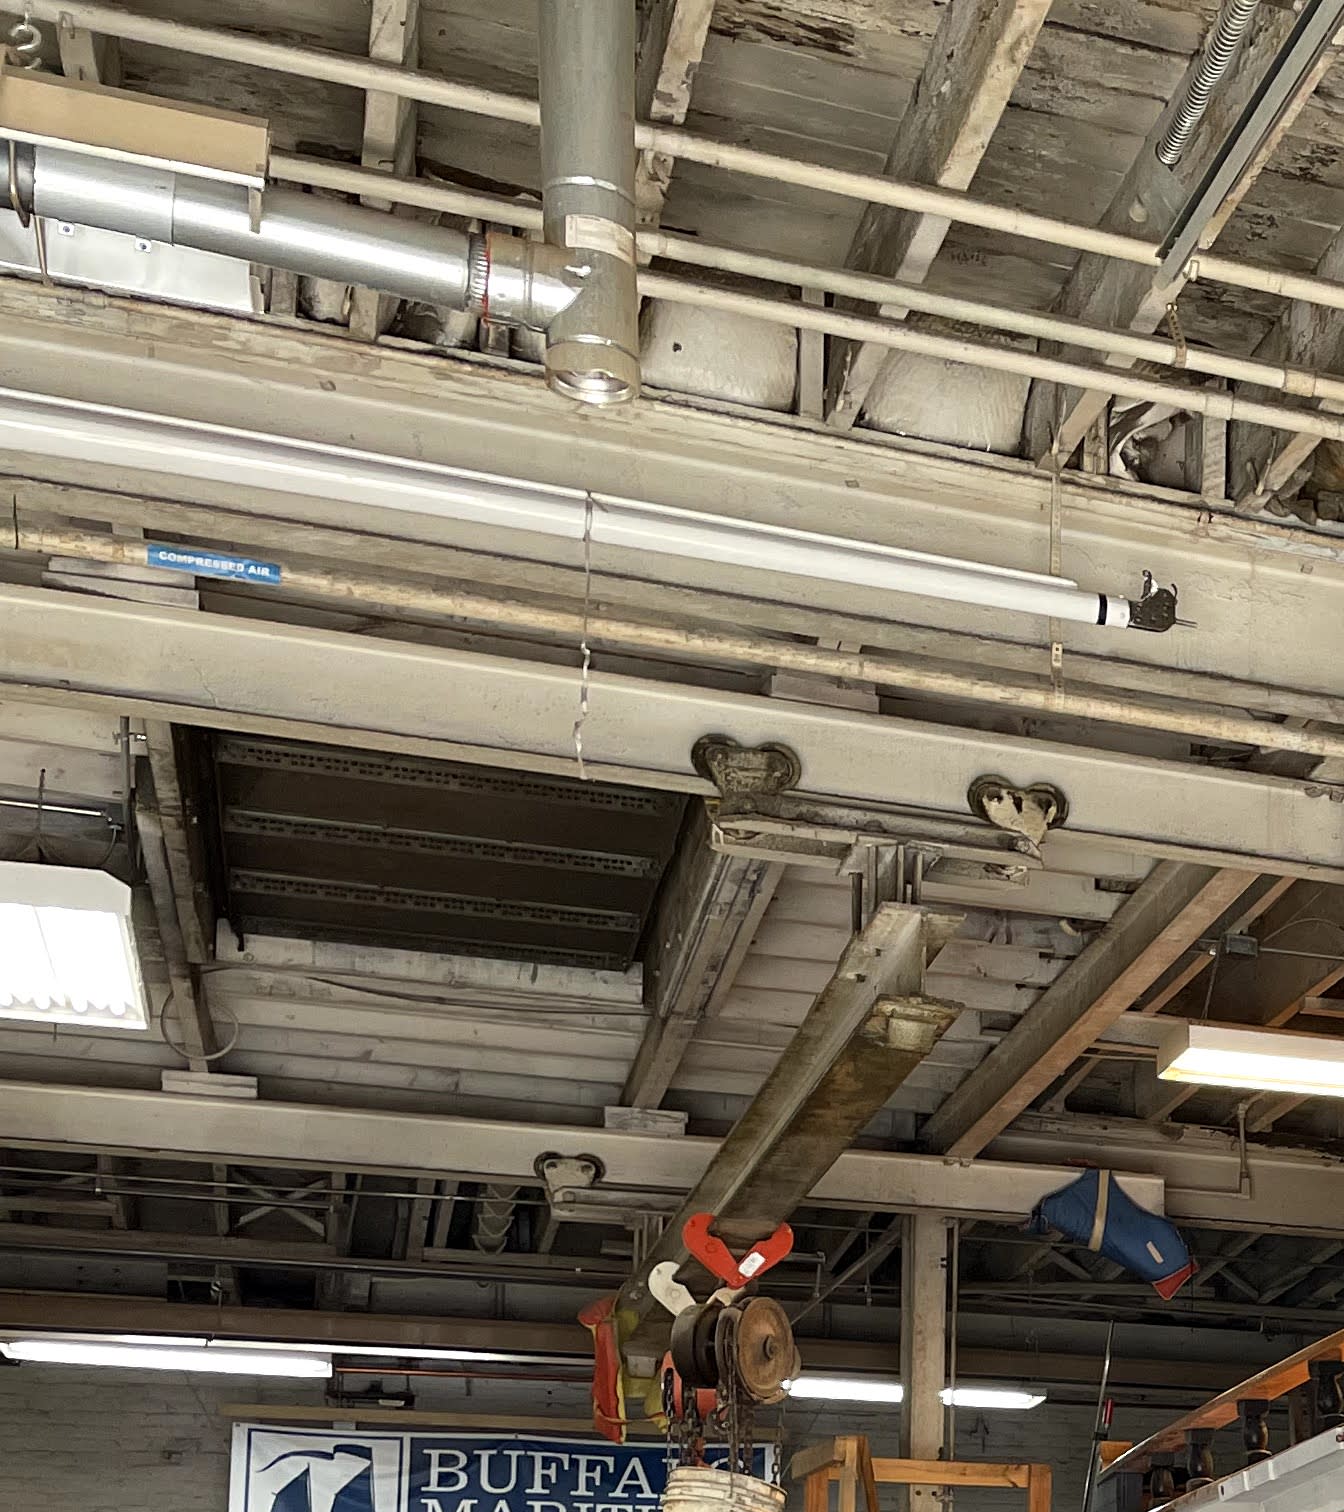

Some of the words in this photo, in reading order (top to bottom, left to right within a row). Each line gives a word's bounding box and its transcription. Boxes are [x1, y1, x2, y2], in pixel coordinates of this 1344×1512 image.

[158, 551, 244, 573] COMPRESSED
[248, 564, 270, 577] AIR
[421, 1448, 747, 1499] BUFFA
